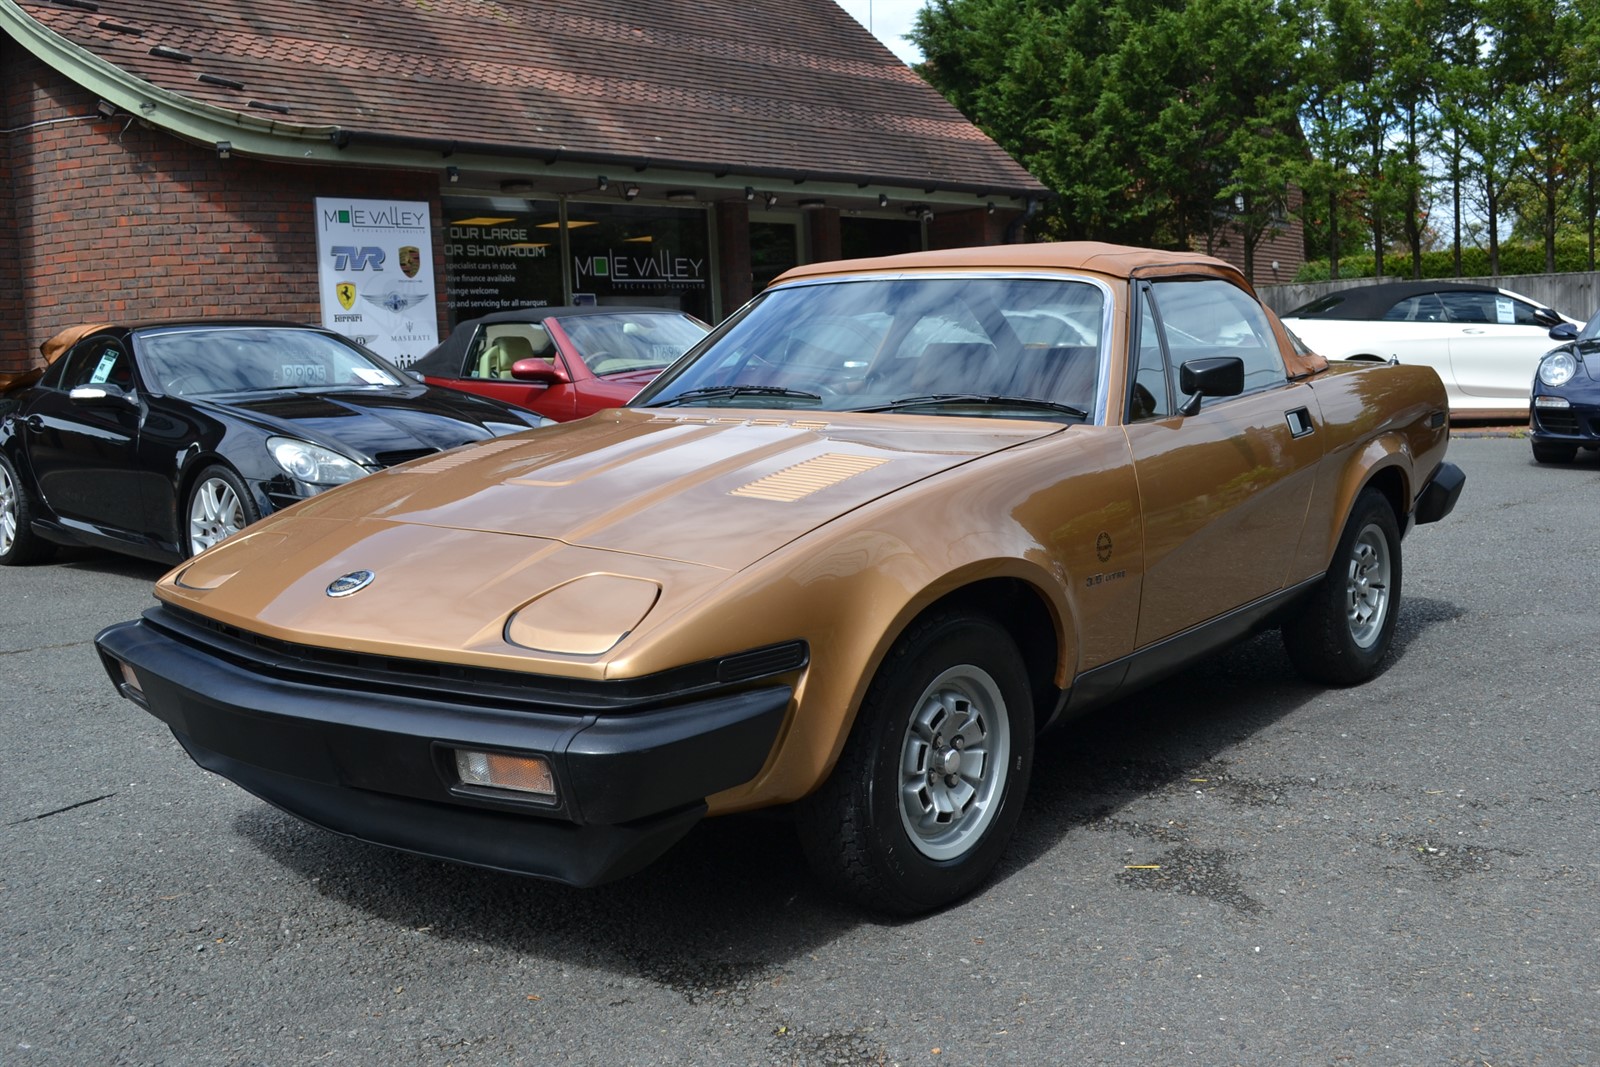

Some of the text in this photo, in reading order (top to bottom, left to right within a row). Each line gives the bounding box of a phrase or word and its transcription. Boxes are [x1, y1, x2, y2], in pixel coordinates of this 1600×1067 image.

[369, 206, 425, 229] VALLEY
[450, 227, 479, 239] OUR
[482, 228, 528, 240] LARGE
[444, 244, 546, 257] OR SHOWROOM
[330, 246, 386, 271] TVR
[492, 262, 499, 270] in
[500, 262, 517, 270] stock
[633, 249, 705, 282] VALLEY
[461, 274, 486, 282] finance
[486, 274, 516, 282] available
[447, 287, 499, 297] hange welcome
[447, 298, 548, 309] op and servicing for all marques
[334, 314, 363, 323] Ferrari
[1086, 574, 1103, 588] 3.5
